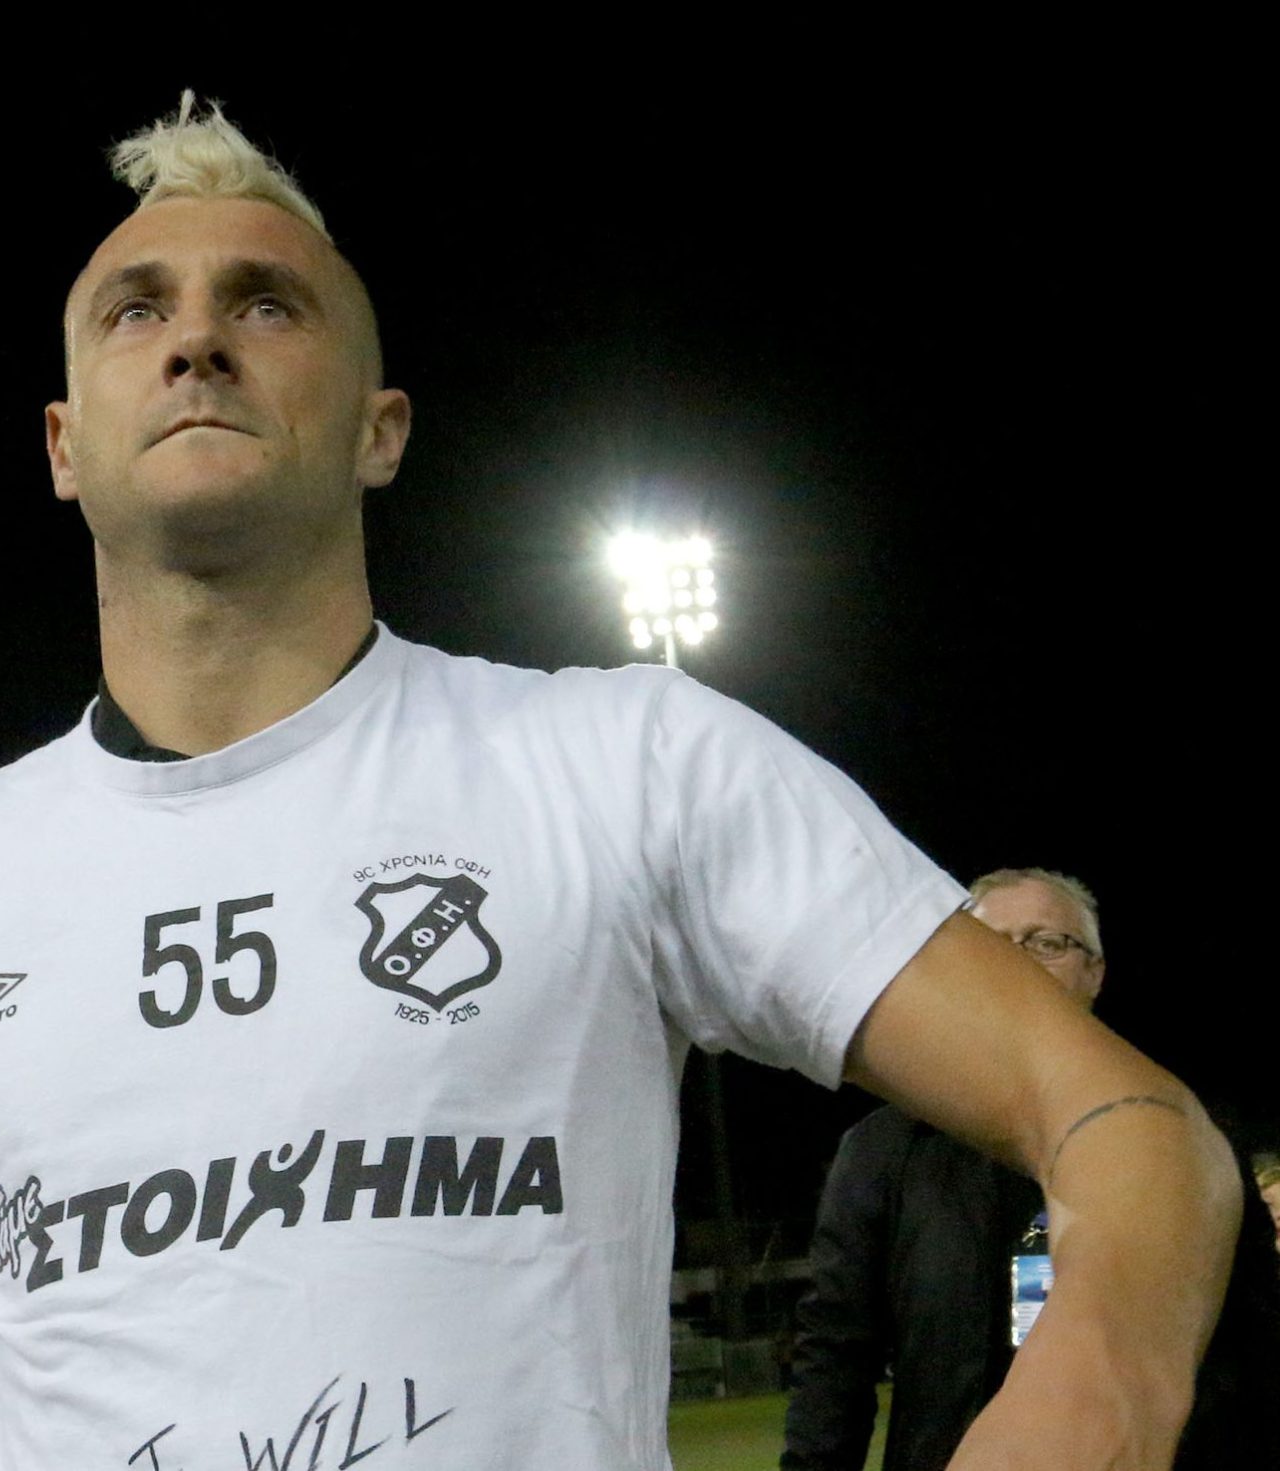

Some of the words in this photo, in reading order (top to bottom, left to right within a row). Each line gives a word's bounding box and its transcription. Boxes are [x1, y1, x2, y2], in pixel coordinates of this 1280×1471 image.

[138, 892, 278, 1029] 55
[394, 1002, 431, 1025] 1925
[446, 1001, 481, 1025] 2015
[25, 1129, 564, 1294] ΣΤΟΙΧΗΜΑ
[237, 1372, 458, 1471] WILL
